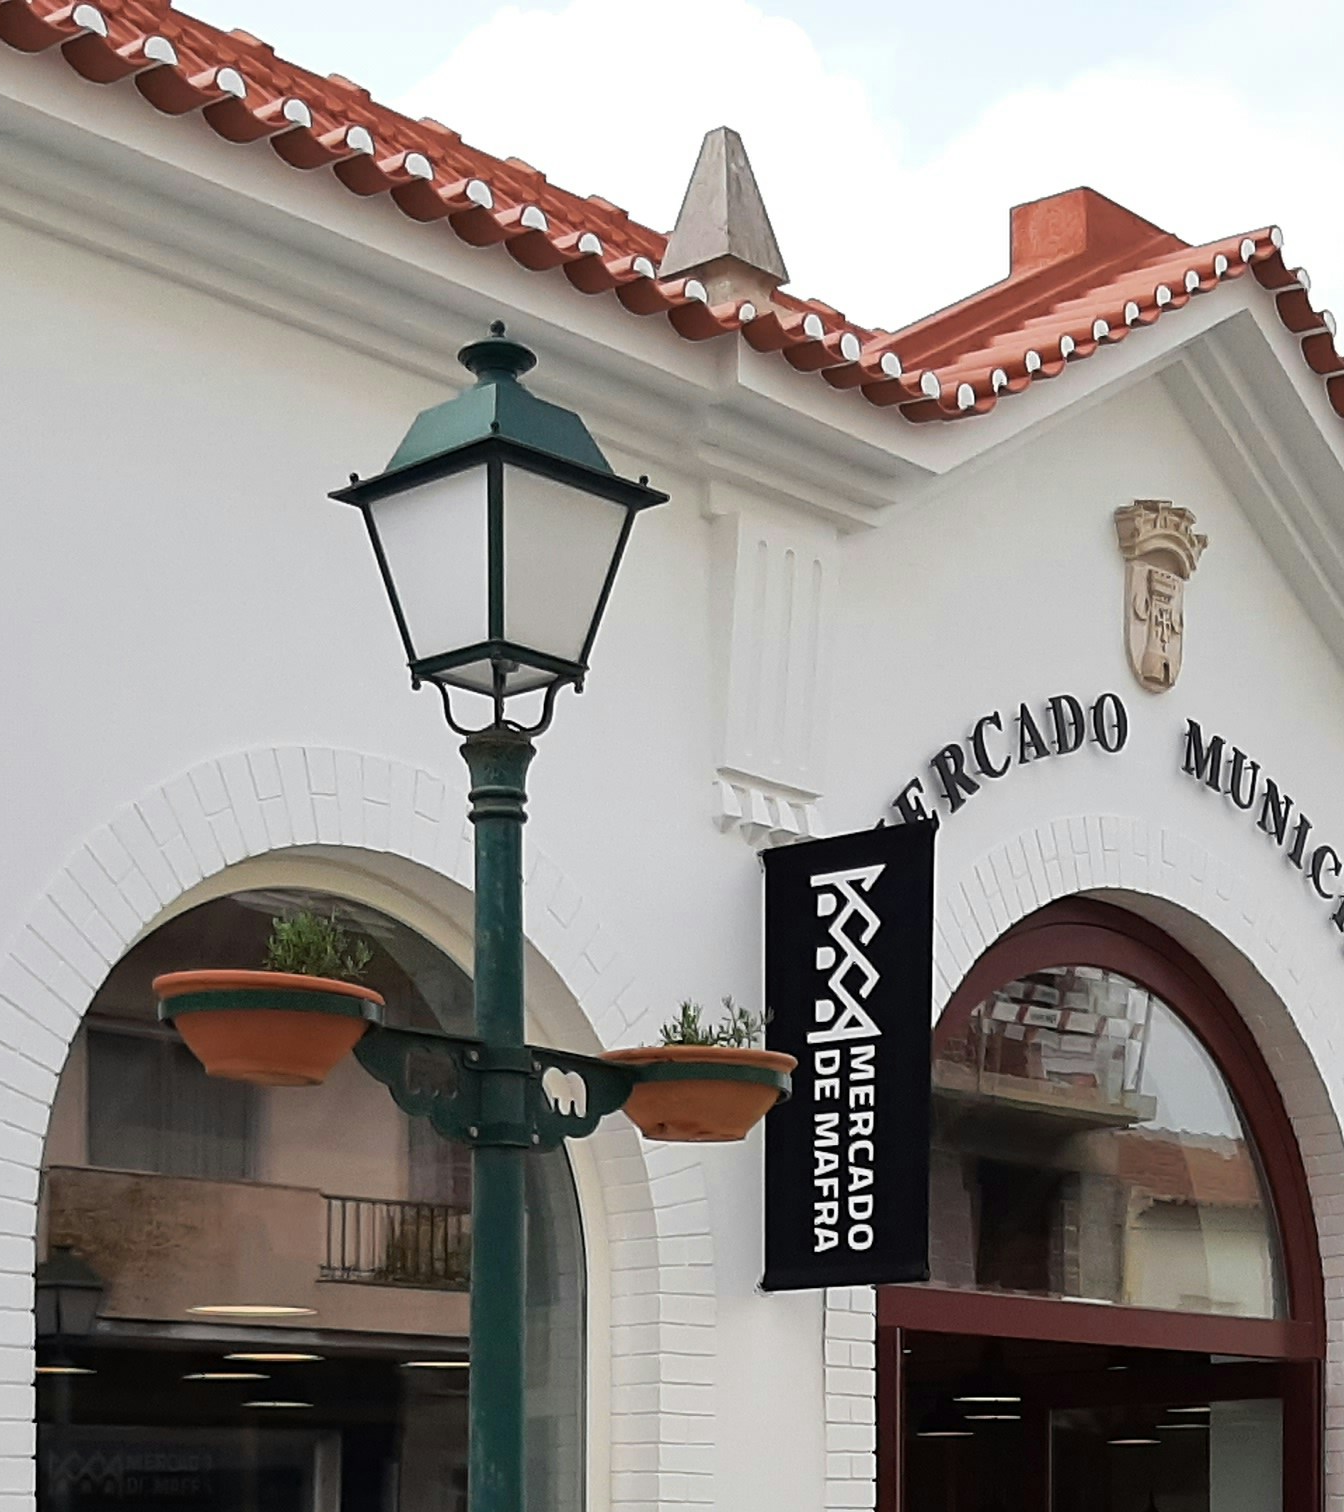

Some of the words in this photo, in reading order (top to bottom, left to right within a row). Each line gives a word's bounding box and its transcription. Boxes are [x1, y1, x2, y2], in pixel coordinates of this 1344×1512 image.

[875, 693, 1128, 829] ERCADO
[814, 1050, 840, 1101] DE
[814, 1112, 840, 1252] MAFRA
[847, 1045, 875, 1250] MERCADO
